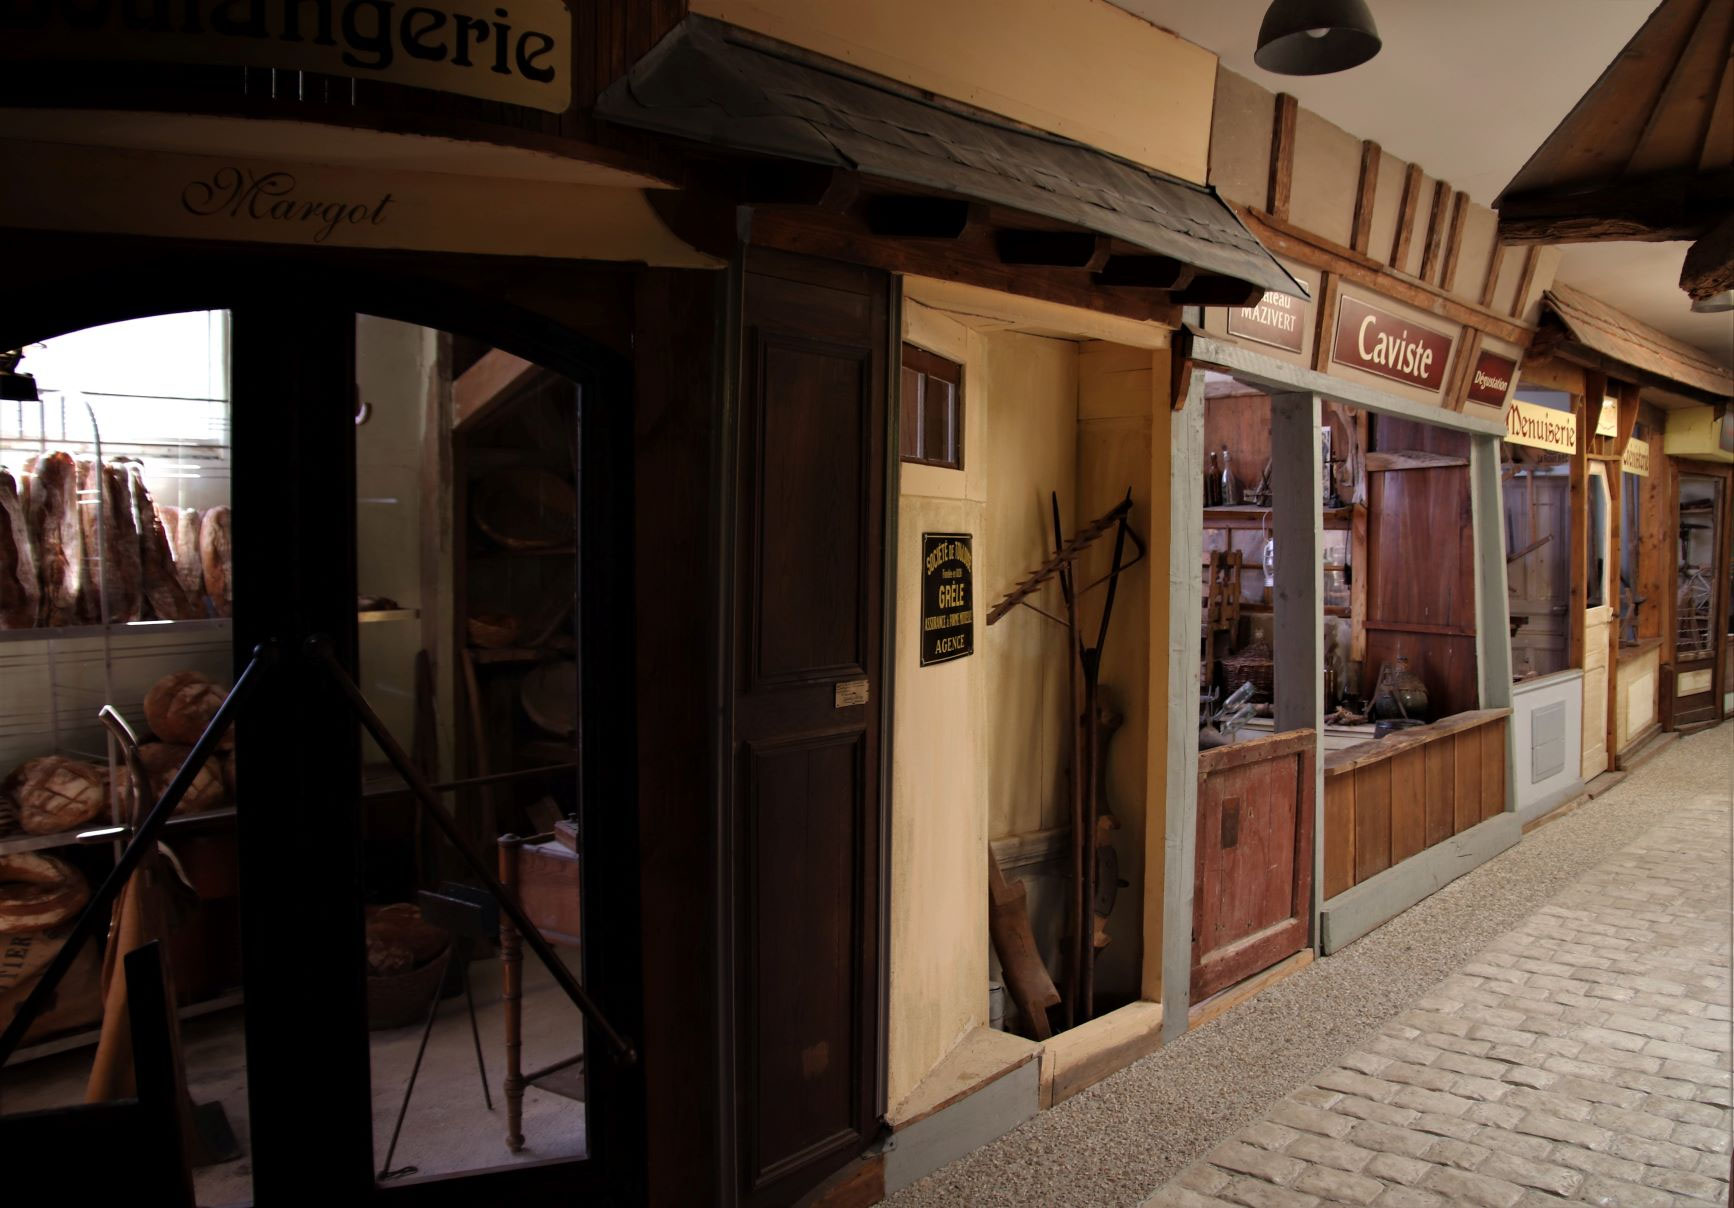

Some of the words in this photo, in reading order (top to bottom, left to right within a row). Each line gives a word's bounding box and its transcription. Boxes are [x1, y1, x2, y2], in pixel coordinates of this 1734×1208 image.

[183, 167, 396, 243] Margot
[1241, 305, 1296, 332] MAZIVERT
[1358, 315, 1433, 379] Caviste
[1474, 370, 1508, 391] Dégustation
[1506, 404, 1575, 449] Menuiserie
[935, 634, 965, 654] AGENCE
